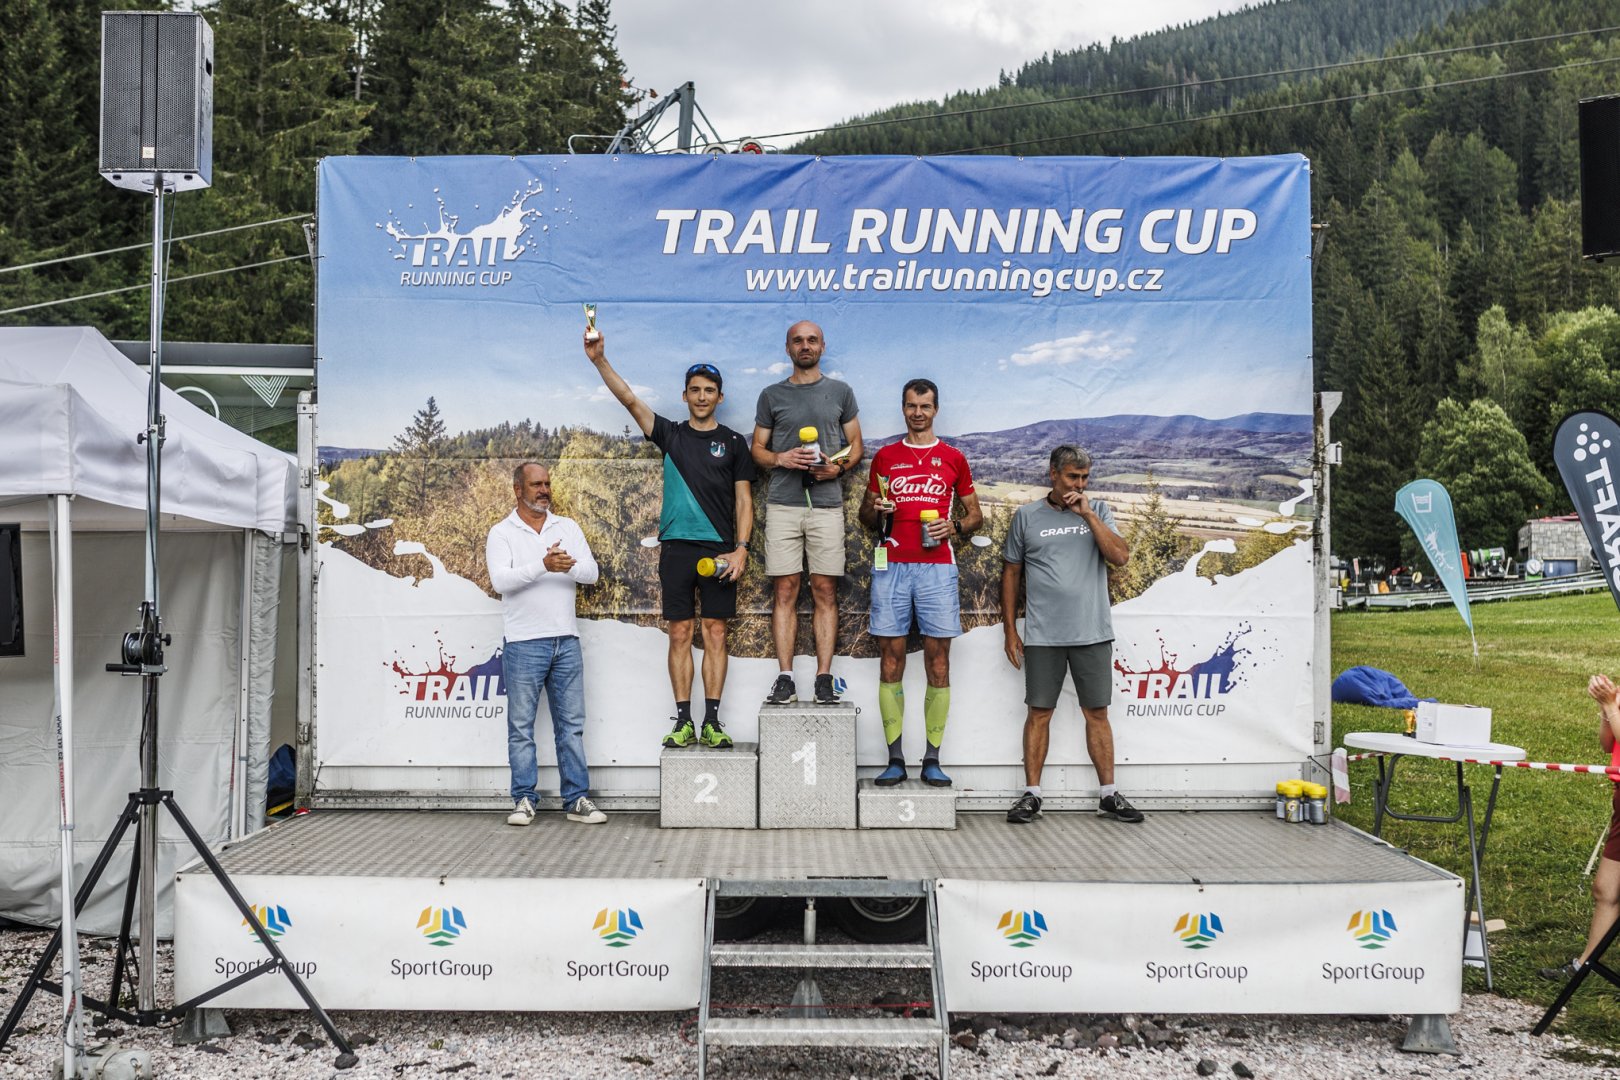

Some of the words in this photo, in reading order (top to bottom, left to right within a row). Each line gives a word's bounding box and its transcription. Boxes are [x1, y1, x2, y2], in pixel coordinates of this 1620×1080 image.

[655, 208, 831, 254] TRAIL
[846, 207, 1124, 254] RUNNING
[1139, 208, 1258, 255] CUP
[399, 237, 518, 267] TRAIL
[400, 271, 475, 286] RUNNING
[479, 271, 513, 286] CUP
[746, 260, 1165, 297] www.trailrunningcup.cz
[890, 475, 947, 496] Carla
[896, 495, 940, 504] Chocolates
[1039, 526, 1079, 538] CRAFT
[400, 674, 507, 701] TRAIL
[1122, 672, 1230, 699] TRAIL
[405, 706, 471, 719] RUNNING
[475, 706, 504, 719] CUP
[1126, 704, 1193, 717] RUNNING
[1196, 704, 1226, 717] CUP
[791, 741, 817, 786] 1
[693, 772, 719, 804] 2
[897, 799, 916, 822] 3
[391, 958, 493, 980] SportGroup
[566, 960, 669, 981] SportGroup
[970, 961, 1073, 982] SportGroup
[1145, 962, 1248, 983] SportGroup
[1322, 962, 1425, 984] SportGroup
